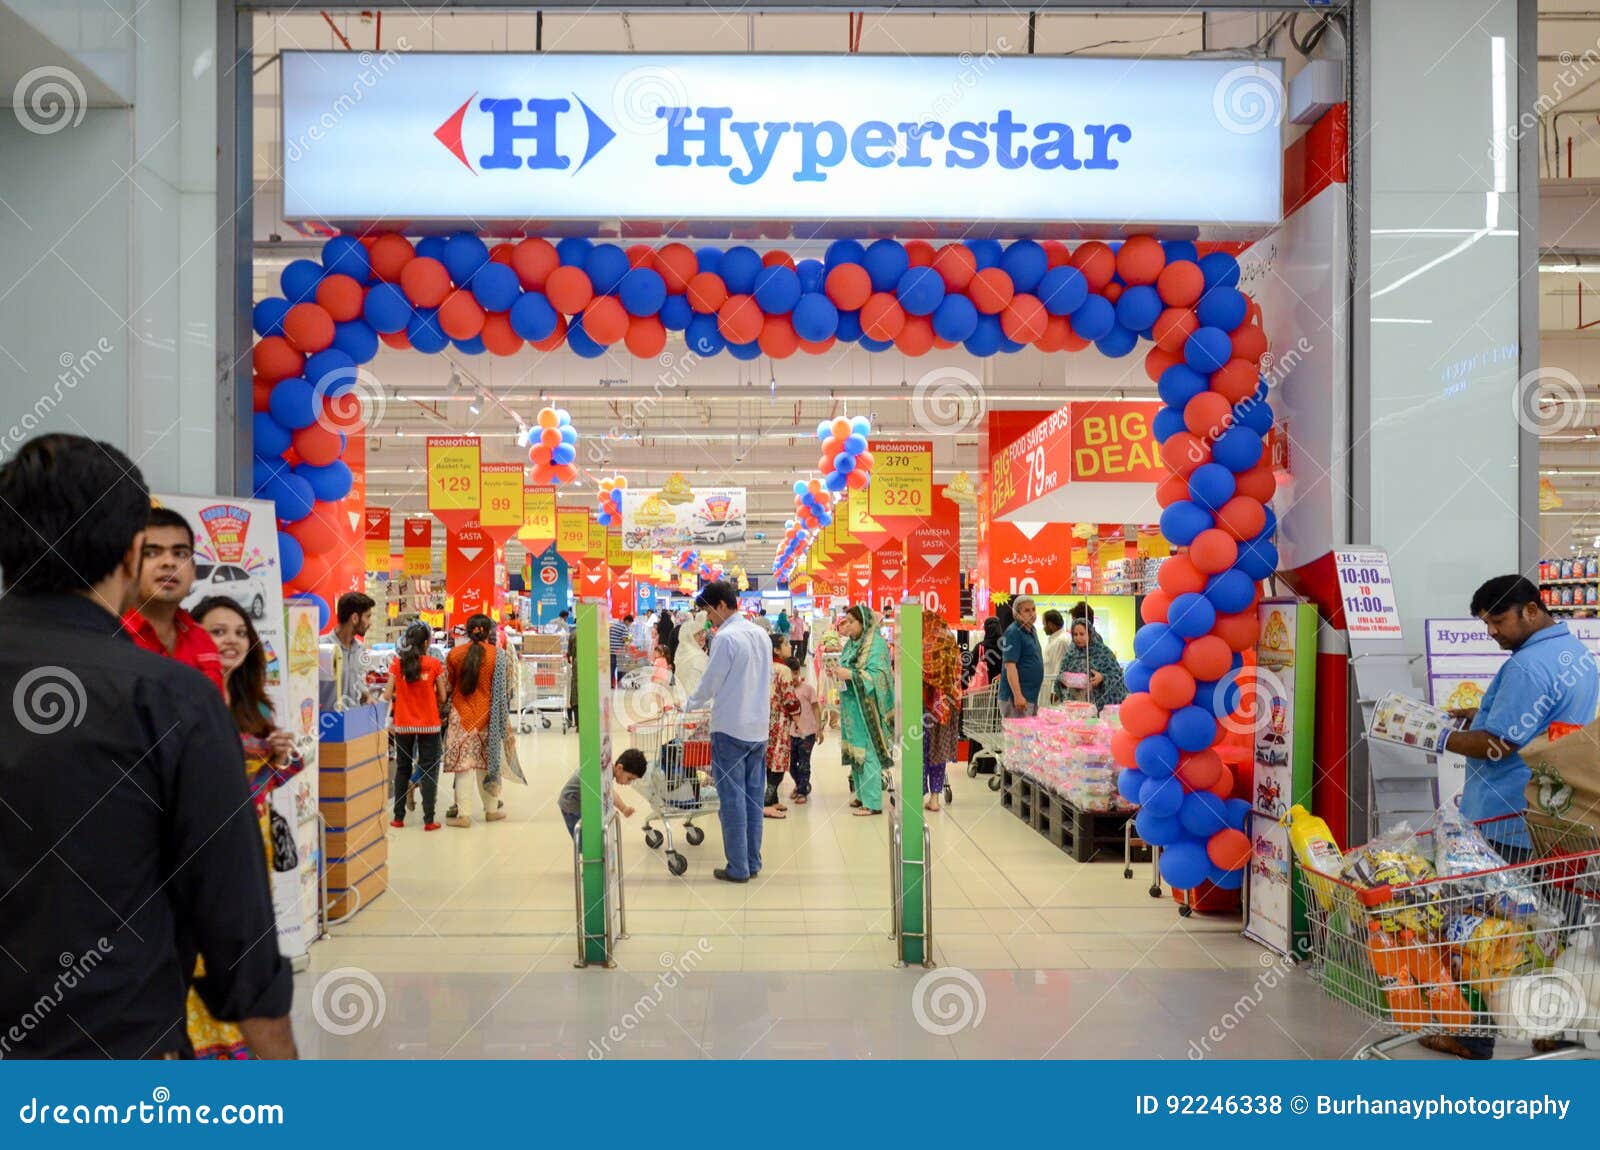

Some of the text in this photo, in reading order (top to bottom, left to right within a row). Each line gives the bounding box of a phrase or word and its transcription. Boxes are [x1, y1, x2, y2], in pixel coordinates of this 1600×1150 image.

[479, 97, 570, 170] H
[655, 106, 1132, 186] Hyperstar
[1084, 412, 1147, 445] BIG
[429, 438, 479, 447] PROMOTION
[1010, 436, 1025, 459] FOOD
[1027, 420, 1048, 450] SAVER
[875, 444, 925, 452] PROMOTION
[886, 455, 910, 466] 370
[993, 449, 1010, 485] BIG
[1025, 445, 1057, 502] 79 PKR
[438, 476, 471, 492] 129
[884, 489, 922, 506] 320
[992, 475, 1014, 514] DEAL
[491, 497, 511, 511] 99
[460, 532, 482, 540] SASTA
[915, 528, 951, 536] HAMESHA
[922, 540, 944, 548] SASTA
[1340, 568, 1380, 584] 10:00
[1360, 586, 1371, 595] TO
[1345, 596, 1382, 613] 11:00
[1437, 630, 1491, 643] Hypers
